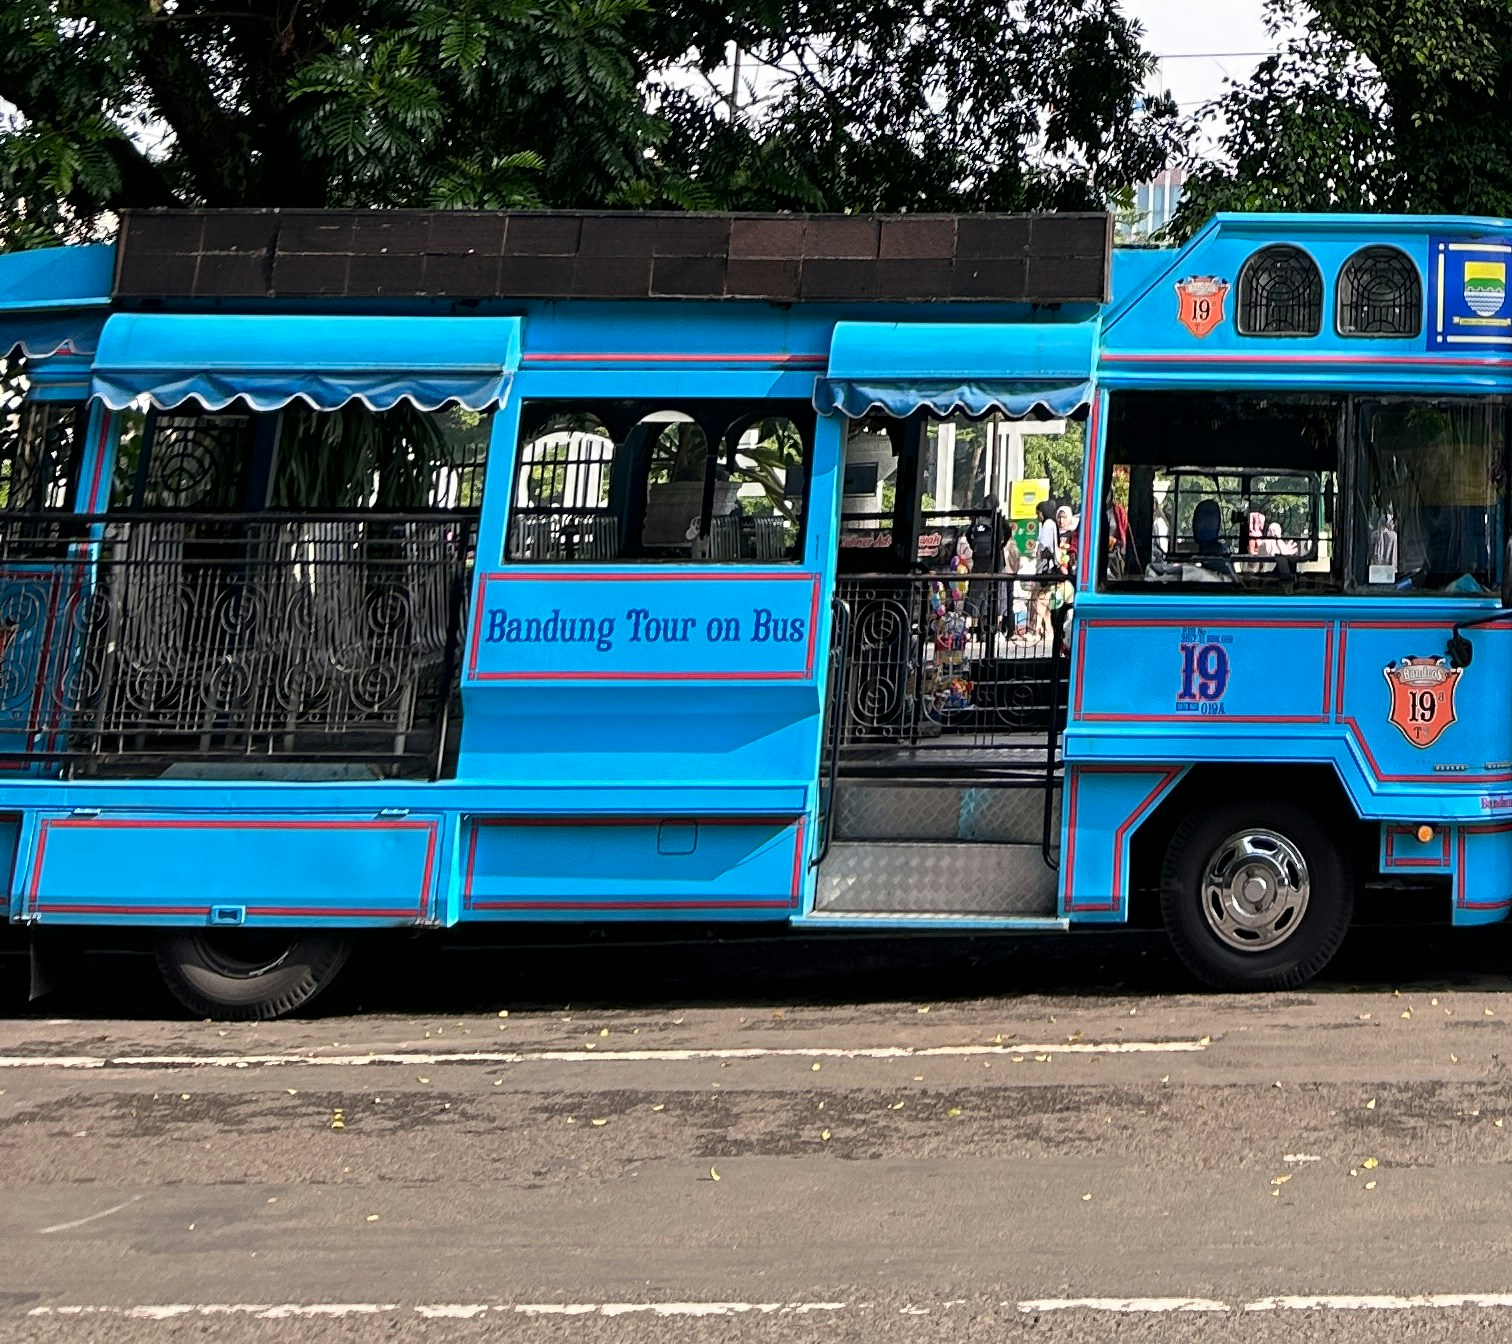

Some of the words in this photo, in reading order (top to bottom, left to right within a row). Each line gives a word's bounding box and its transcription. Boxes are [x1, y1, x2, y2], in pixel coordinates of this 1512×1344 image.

[1191, 298, 1211, 322] 19
[485, 608, 616, 653] Bandung
[626, 608, 697, 643] Tour
[706, 616, 741, 643] on
[750, 608, 806, 643] Bus
[1178, 643, 1230, 702] 19
[1408, 690, 1437, 723] 19
